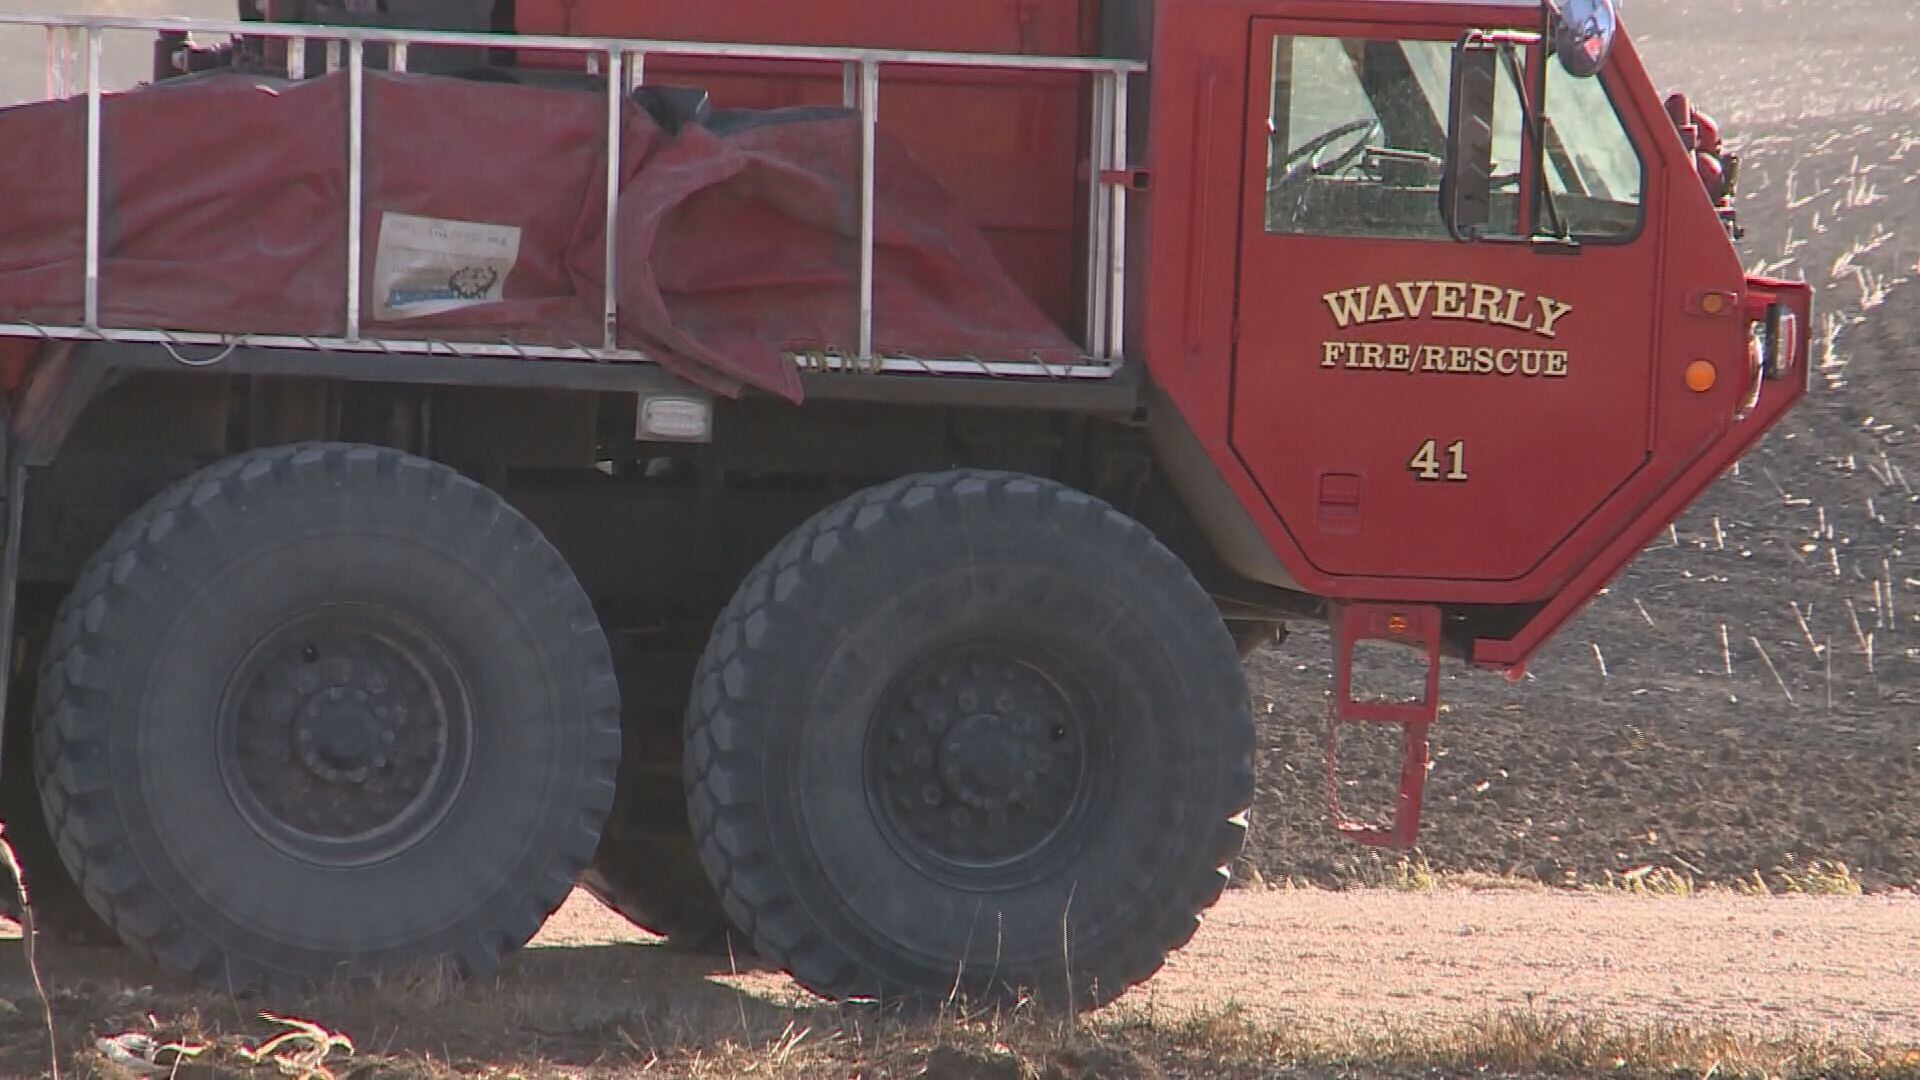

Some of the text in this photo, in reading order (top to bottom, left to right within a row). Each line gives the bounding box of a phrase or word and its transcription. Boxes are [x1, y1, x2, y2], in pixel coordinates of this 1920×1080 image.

[1322, 281, 1573, 338] WAVERLY
[1320, 341, 1569, 377] FIRE/RESCUE
[1408, 439, 1469, 481] 41
